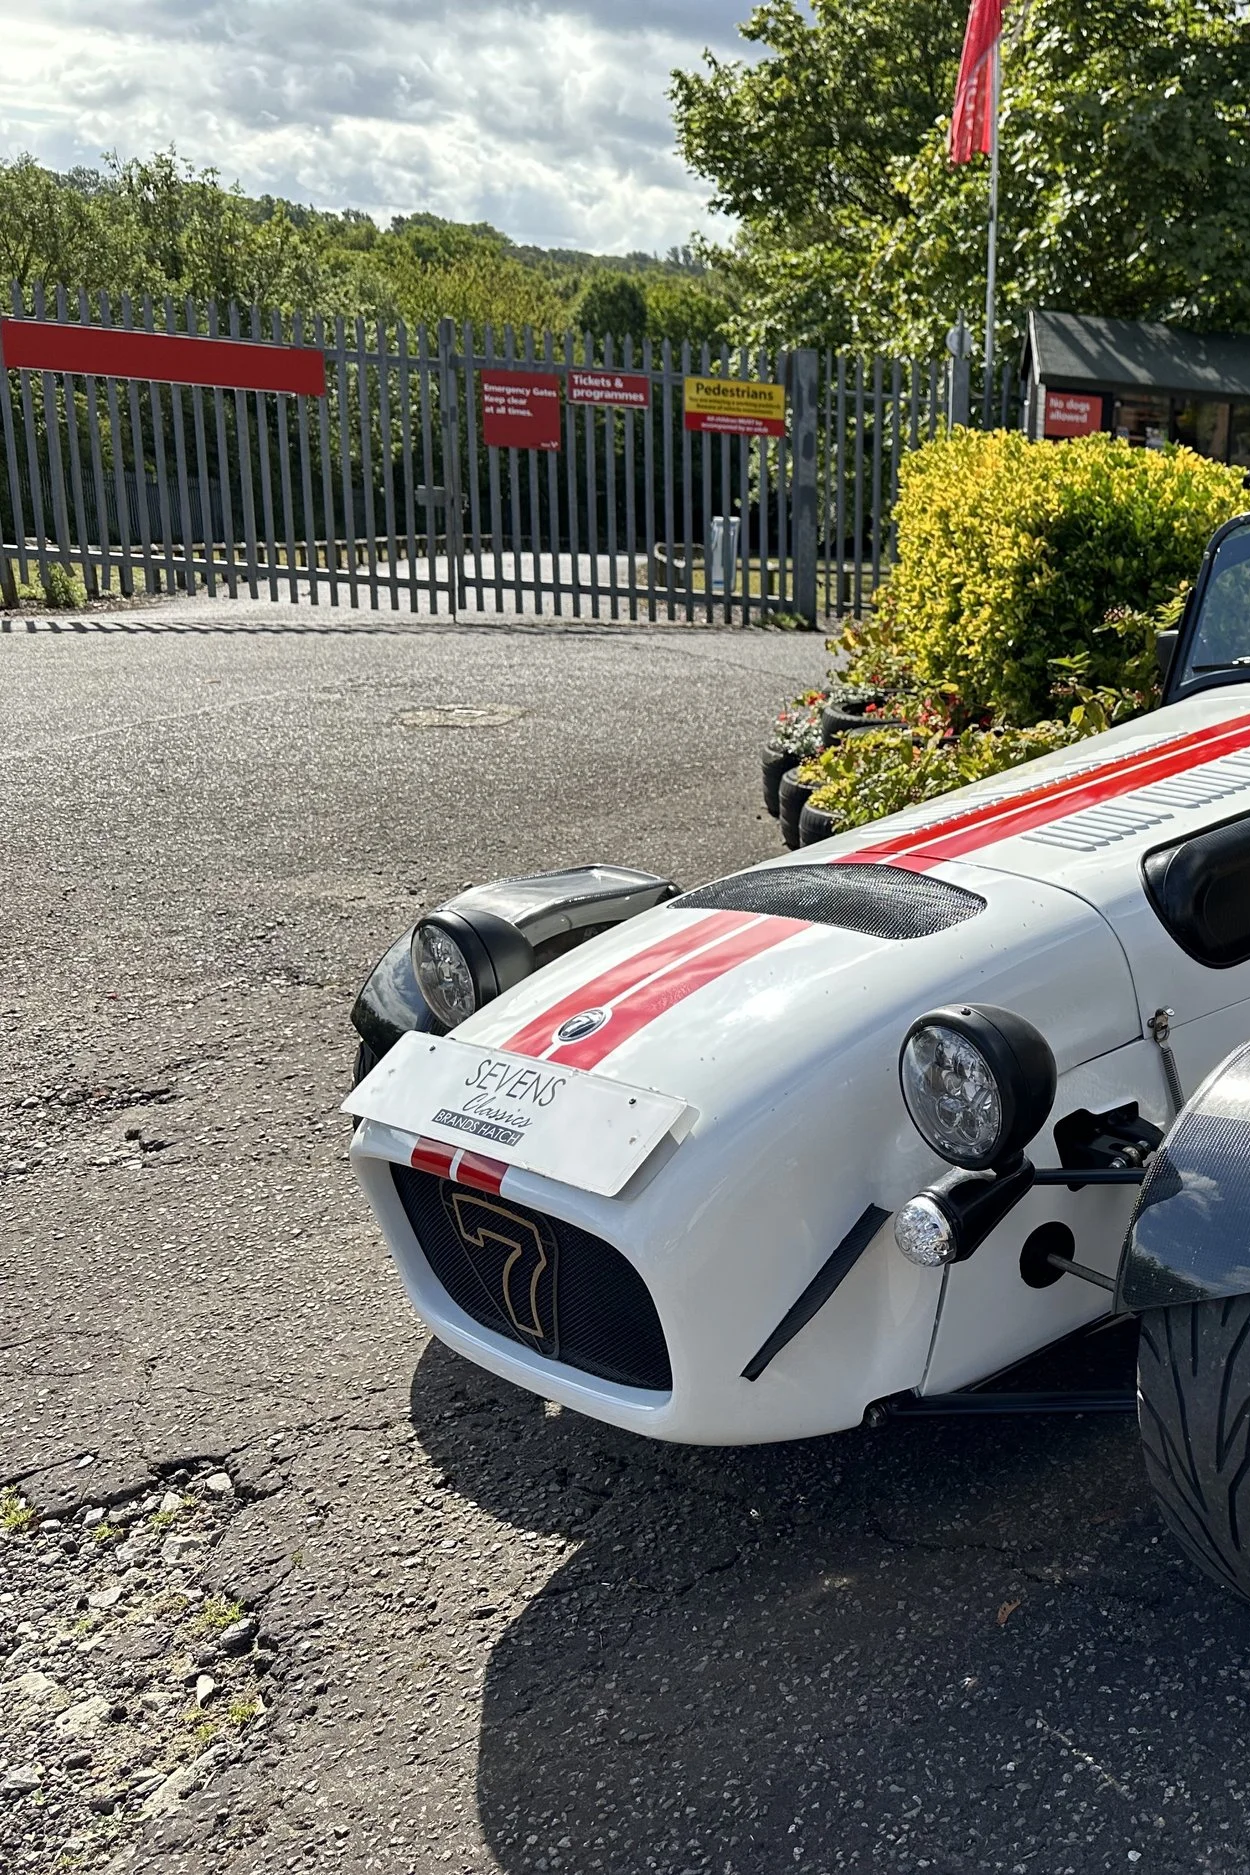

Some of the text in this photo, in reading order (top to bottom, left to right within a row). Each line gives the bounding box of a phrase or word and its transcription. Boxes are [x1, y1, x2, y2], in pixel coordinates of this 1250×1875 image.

[573, 375, 624, 389] Tickets &
[483, 383, 557, 398] Emergency Gates
[573, 388, 645, 402] programmes
[696, 382, 774, 401] Pedestrians
[484, 394, 528, 406] Keep clear
[1049, 397, 1091, 413] No dogs
[496, 407, 506, 415] all
[1049, 409, 1088, 423] allowed
[465, 1059, 567, 1107] SEVENS
[462, 1092, 533, 1128] Classics
[435, 1111, 521, 1146] BRANDS HATCH
[452, 1192, 547, 1338] 7
